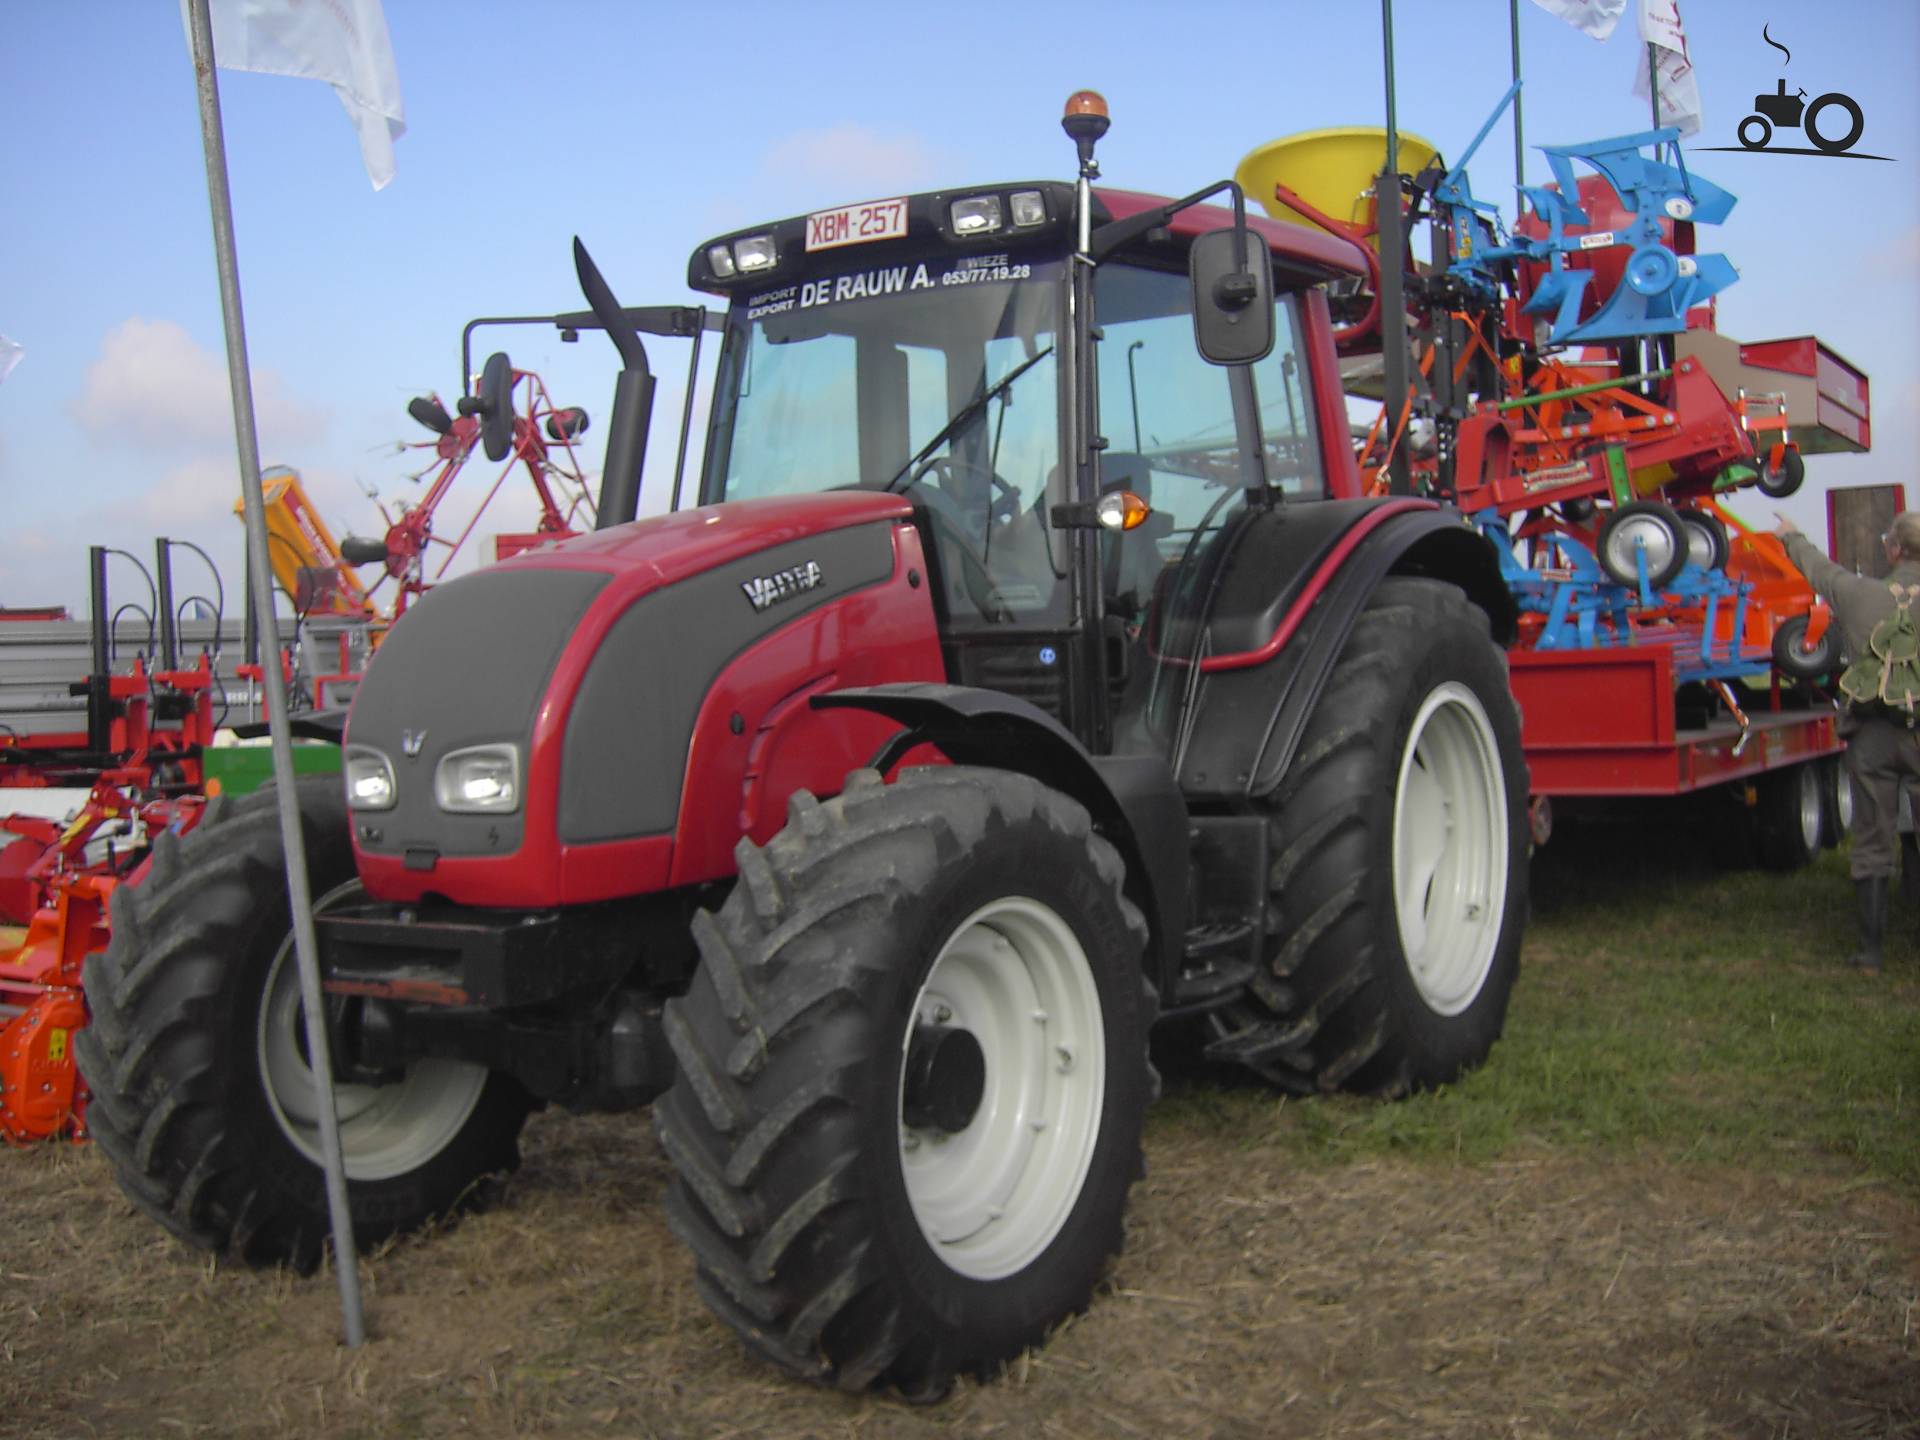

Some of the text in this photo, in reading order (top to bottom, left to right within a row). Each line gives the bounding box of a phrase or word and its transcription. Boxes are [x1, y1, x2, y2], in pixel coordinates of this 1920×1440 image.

[810, 204, 901, 246] XBM-257
[800, 263, 936, 308] DE RAUW A.
[941, 264, 1031, 286] 053/77.19.28
[749, 286, 798, 307] IMPORT
[747, 299, 796, 320] EXPORT
